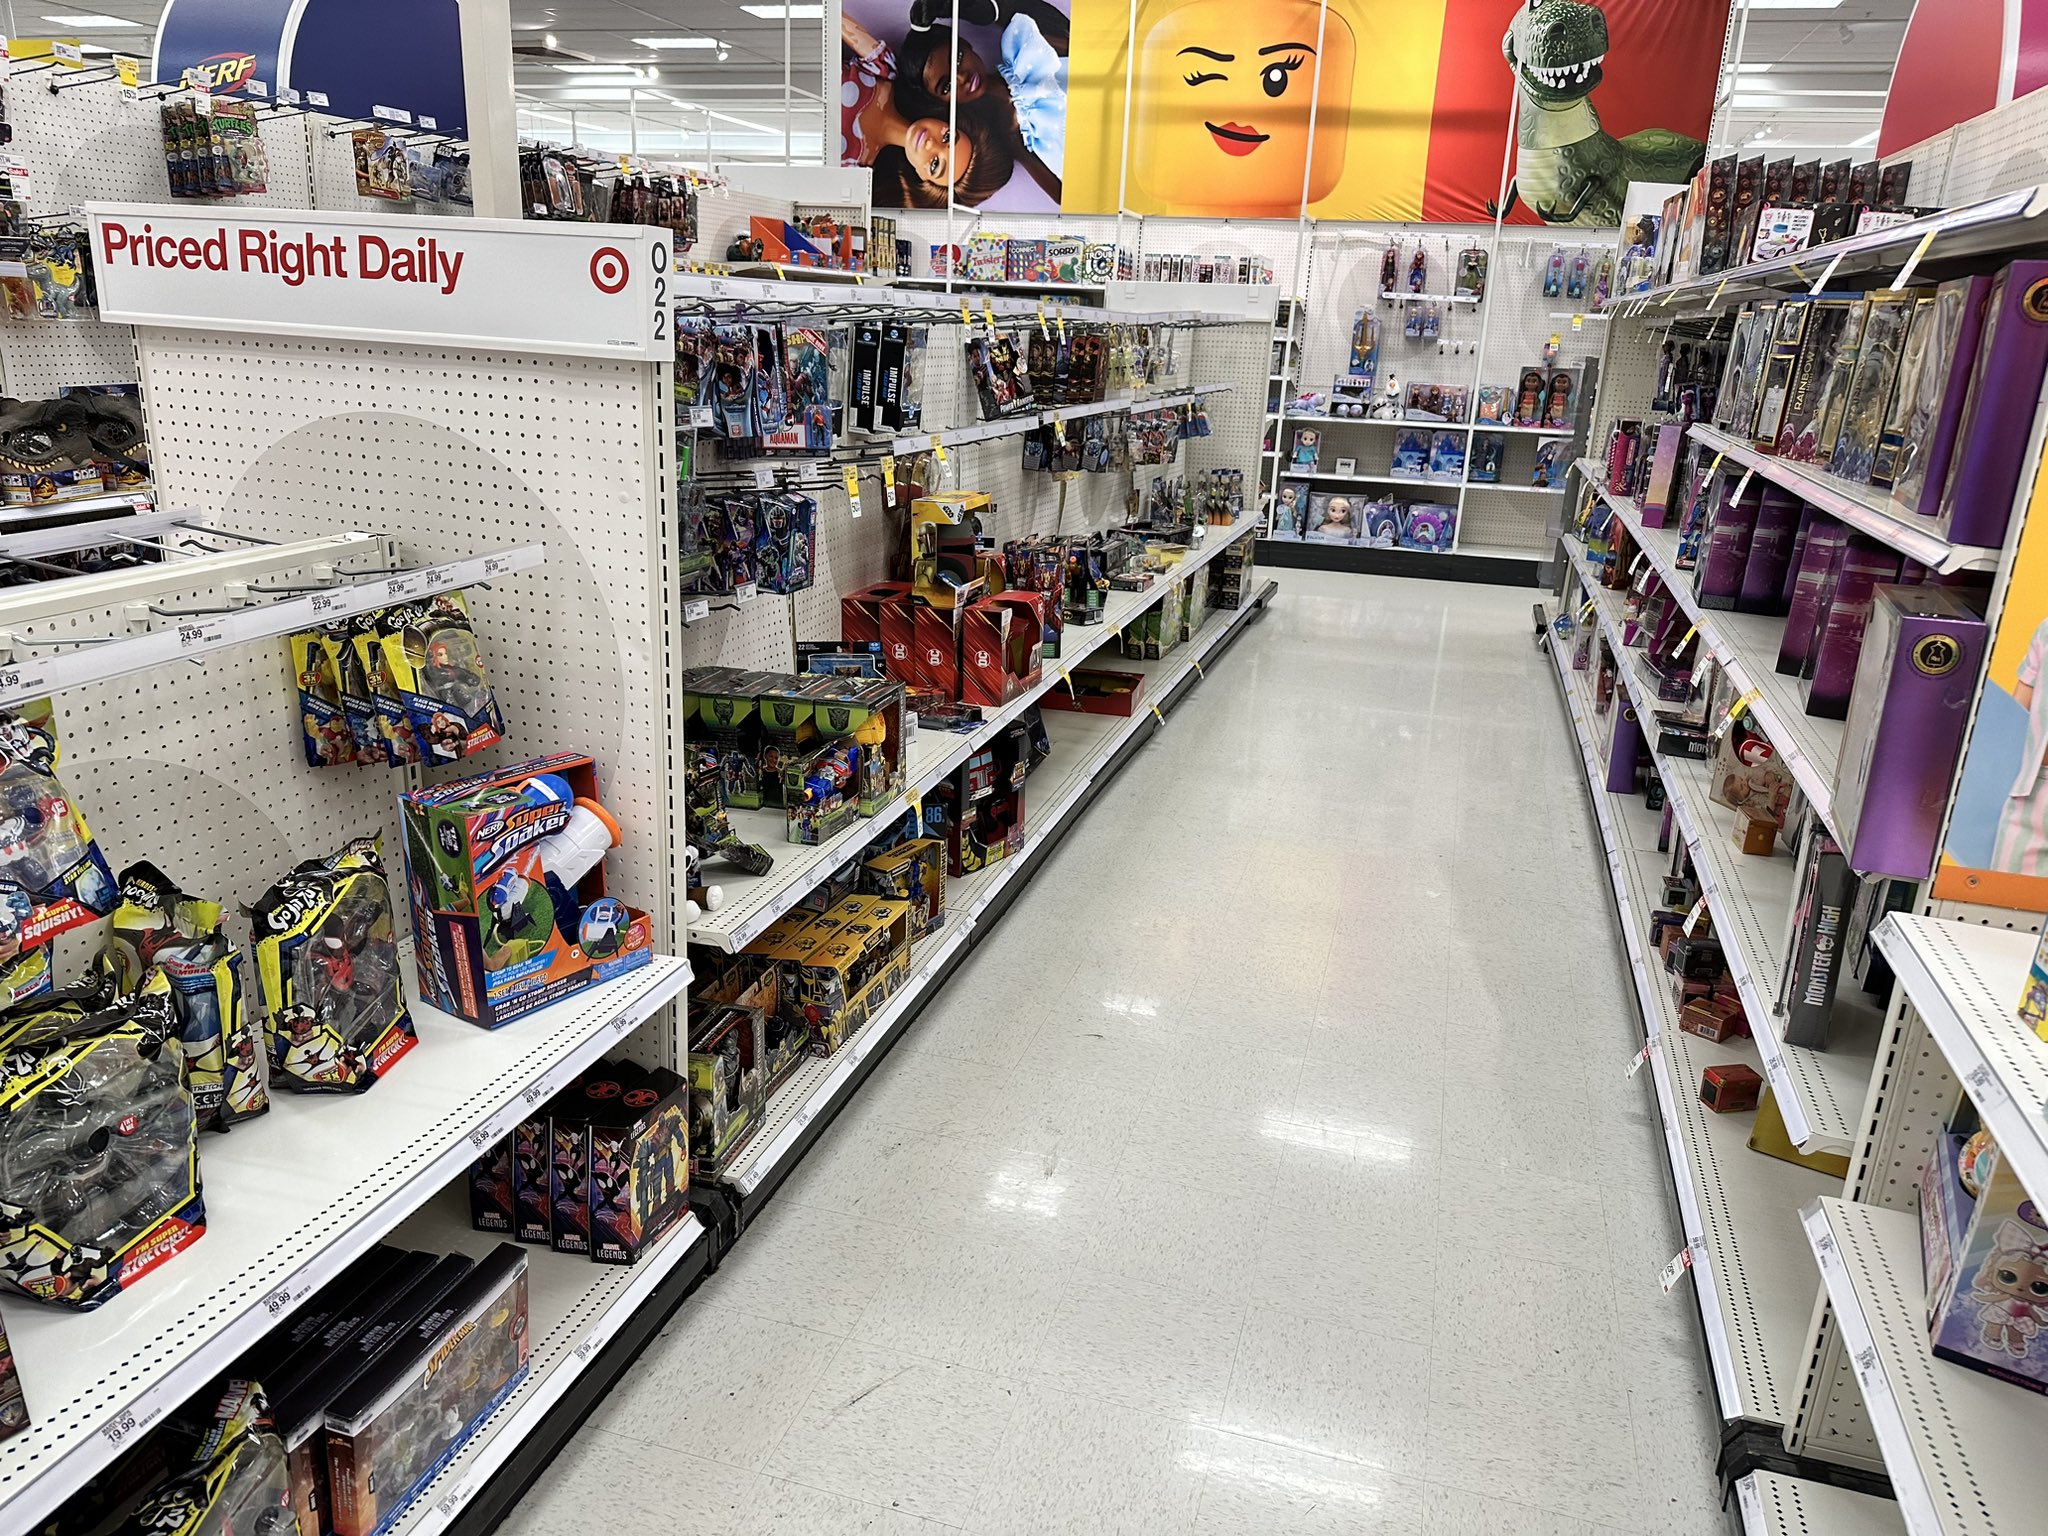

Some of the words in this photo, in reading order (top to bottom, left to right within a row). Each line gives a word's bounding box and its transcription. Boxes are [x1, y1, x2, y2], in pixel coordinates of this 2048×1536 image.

[211, 117, 254, 137] TURTLES
[101, 222, 229, 271] Priced
[238, 228, 349, 287] Right
[357, 234, 465, 296] Daily
[971, 253, 1002, 267] Twister
[1048, 246, 1079, 257] SORRY!
[651, 241, 667, 341] 022
[861, 369, 872, 406] IMPULSE
[887, 366, 898, 403] IMPULSE
[1793, 351, 1816, 412] RAINBOW
[769, 432, 799, 445] AQUAMAN
[485, 562, 499, 573] 24.99
[426, 574, 442, 585] 24.99
[388, 583, 405, 595] 24.99
[312, 599, 331, 610] 22.99
[180, 629, 203, 643] 24.99
[929, 650, 941, 664] DC
[977, 651, 989, 667] DC
[476, 821, 502, 840] NERF
[482, 812, 569, 873] Soaker
[46, 903, 71, 919] SUPER
[1816, 904, 1842, 936] HIGH
[24, 907, 84, 941] SQUISHY!
[1803, 951, 1833, 1007] MONSTER
[494, 1001, 511, 1011] GRAB
[527, 987, 546, 999] STOMP
[546, 977, 568, 990] SOAKER
[495, 1007, 525, 1022] LANZADOR
[533, 997, 548, 1007] AGUA
[548, 988, 567, 1000] STOMP
[567, 979, 588, 992] SOAKER
[525, 1088, 541, 1104] 49.99
[472, 1130, 490, 1147] 55.99
[630, 1121, 647, 1140] LEGENDS
[478, 1218, 508, 1229] LEGENDS
[149, 1224, 179, 1247] SUPER
[520, 1229, 550, 1240] LEGENDS
[557, 1239, 588, 1250] LEGENDS
[596, 1249, 627, 1260] LEGENDS
[267, 1291, 292, 1314] 49.99
[106, 1417, 137, 1444] 19.99
